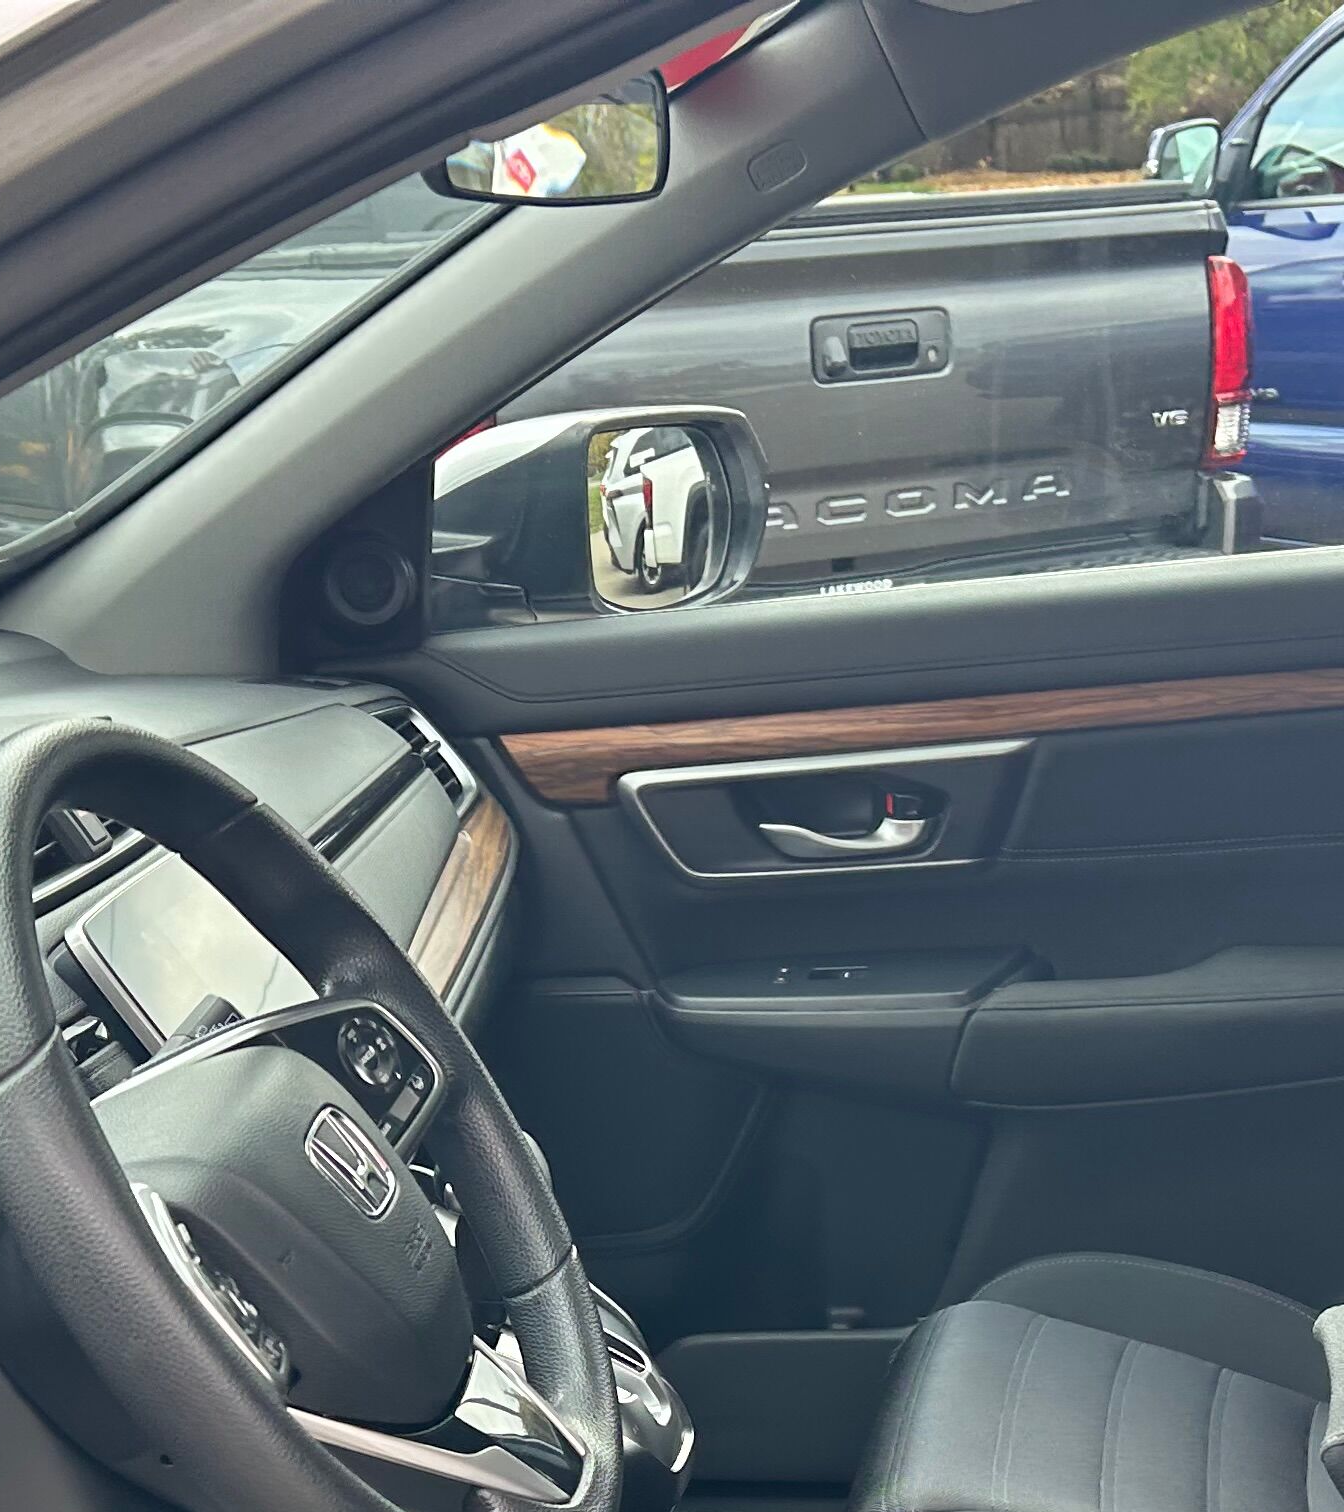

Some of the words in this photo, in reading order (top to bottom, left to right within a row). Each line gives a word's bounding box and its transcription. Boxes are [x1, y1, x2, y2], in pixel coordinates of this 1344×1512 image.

[1151, 408, 1189, 427] V6
[765, 471, 1071, 530] ACOMA
[819, 578, 893, 597] LAKEWOOD
